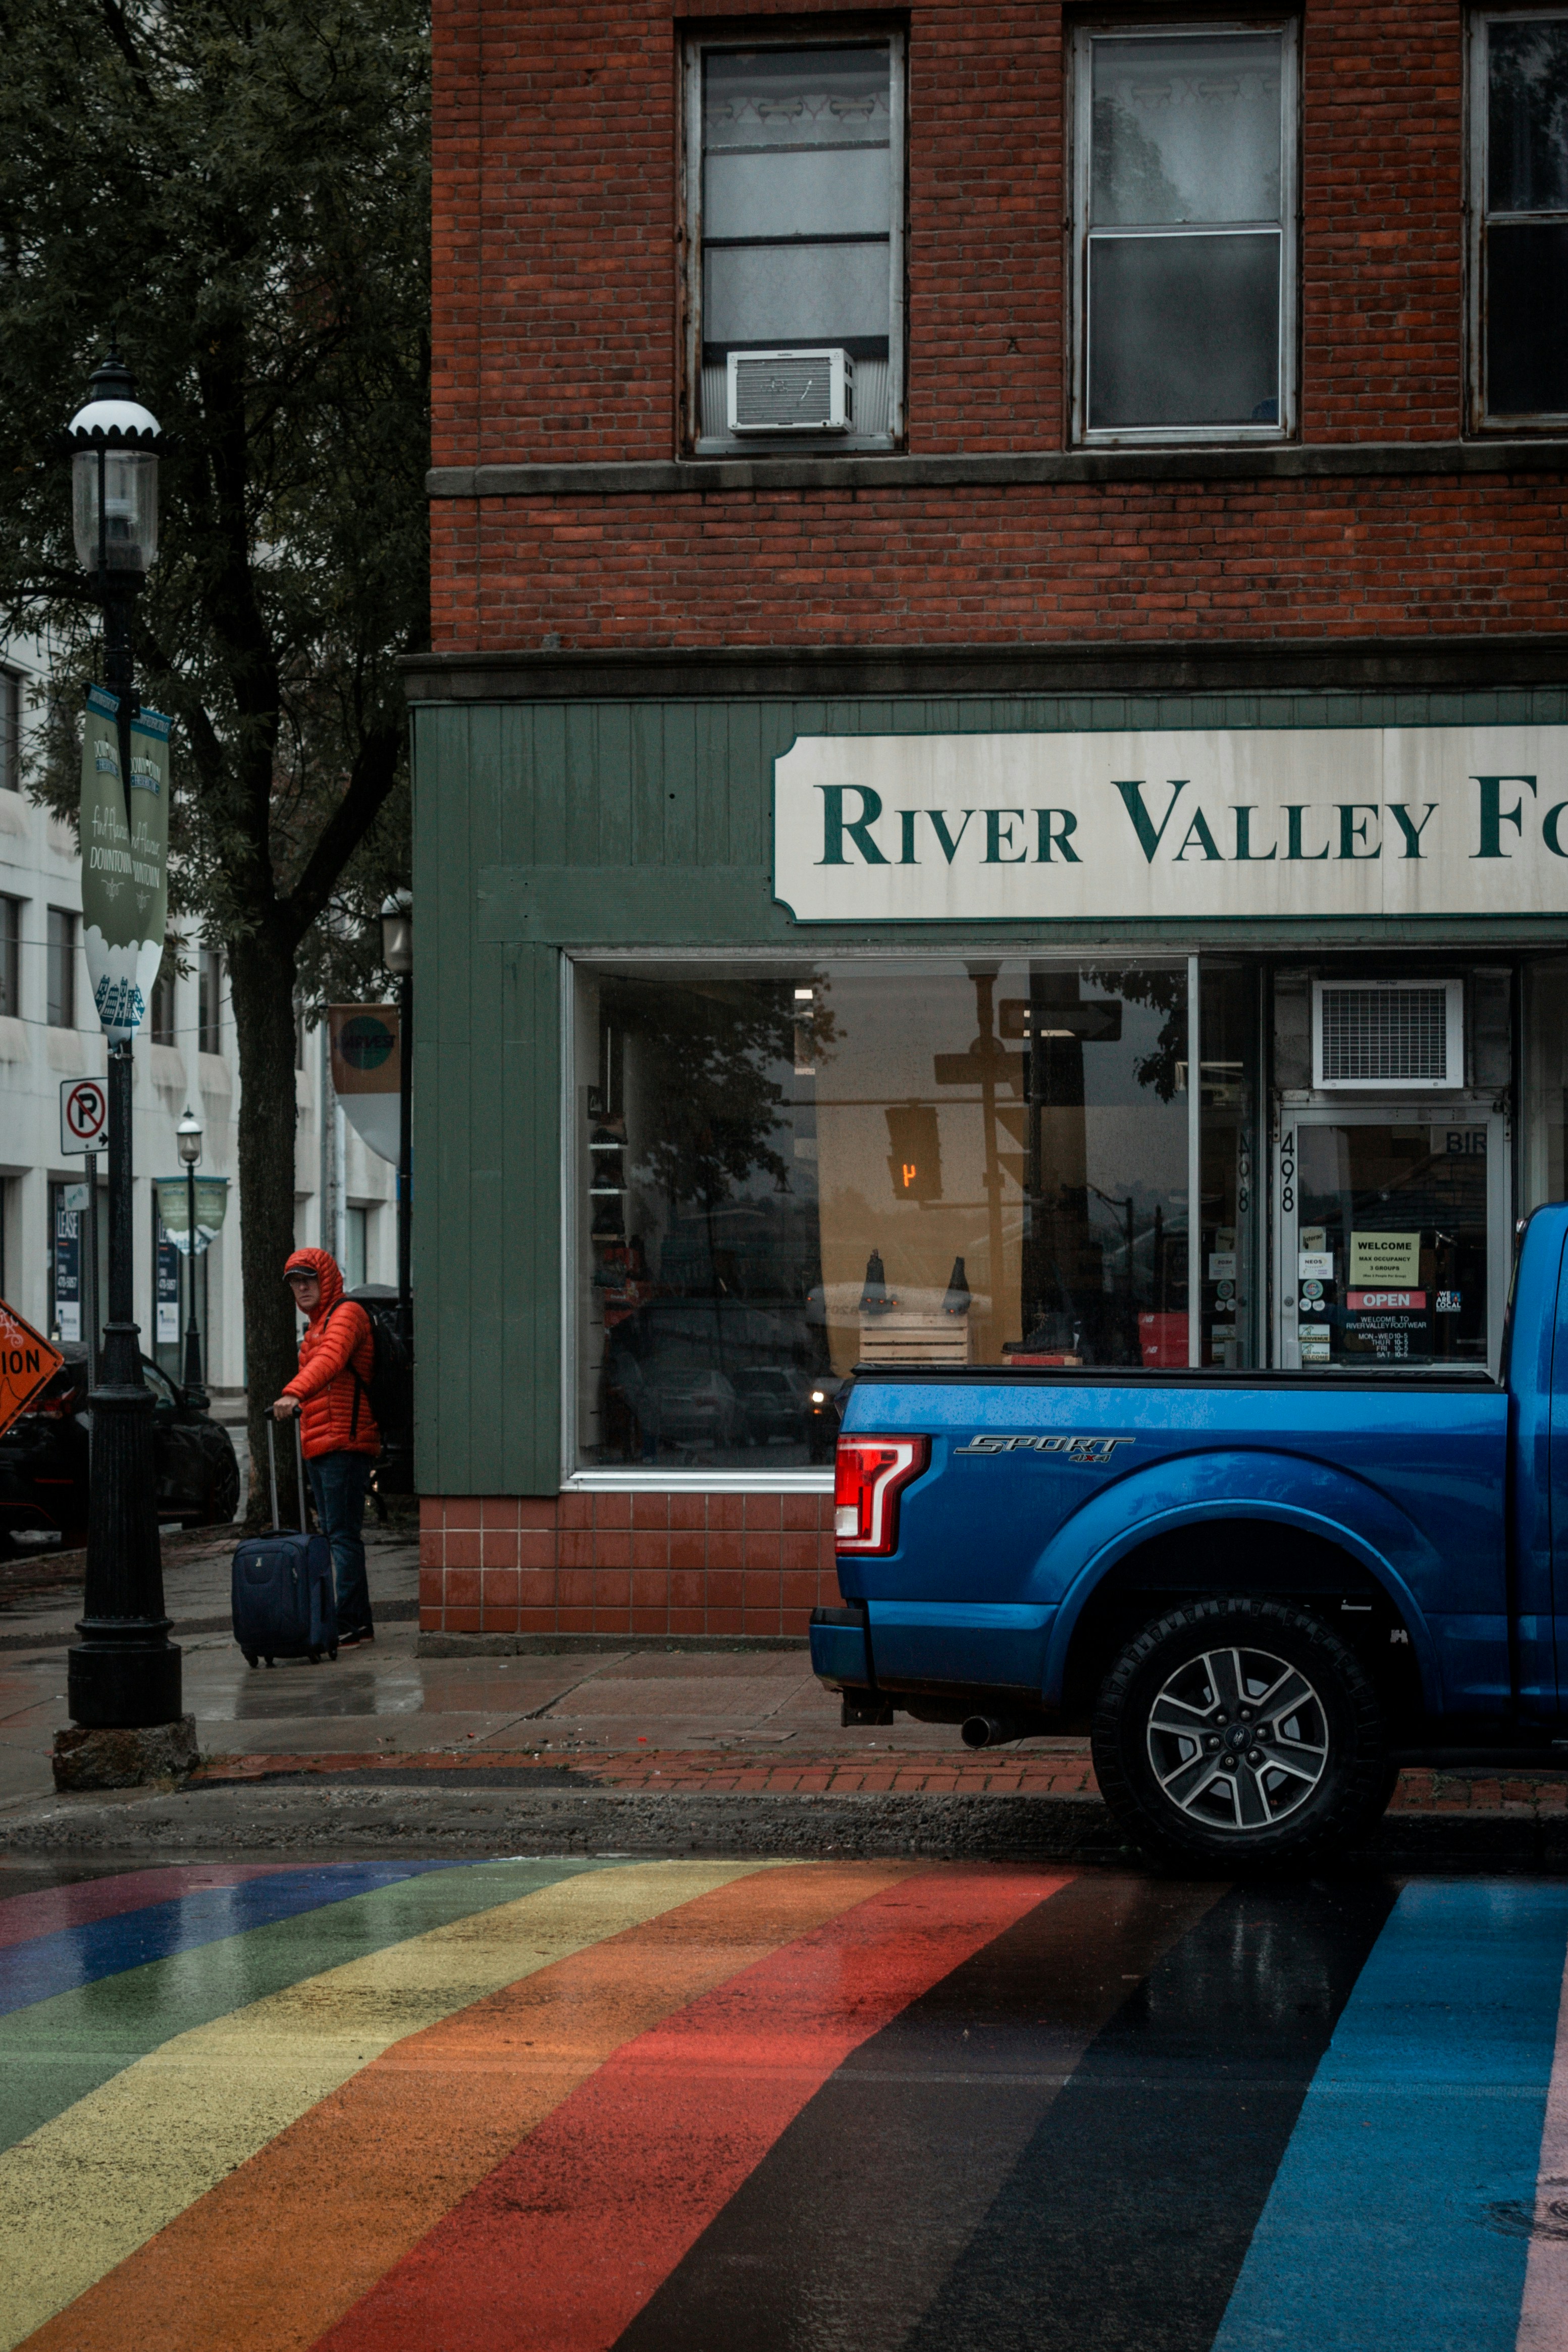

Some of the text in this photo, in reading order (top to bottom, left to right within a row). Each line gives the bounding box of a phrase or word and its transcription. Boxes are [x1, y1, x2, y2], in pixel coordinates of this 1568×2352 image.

[814, 785, 1081, 864] RIVER
[1110, 780, 1439, 864] VALLEY
[90, 846, 132, 874] DOWNTOWN
[132, 860, 160, 888] WNTOWN
[1446, 1131, 1487, 1153] BIR
[1280, 1132, 1294, 1212] 498
[58, 1211, 77, 1239] LEASE
[1357, 1242, 1412, 1250] WELCOME
[1363, 1293, 1409, 1307] OPEN
[2, 1349, 40, 1375] ION
[953, 1434, 1136, 1455] SPORT
